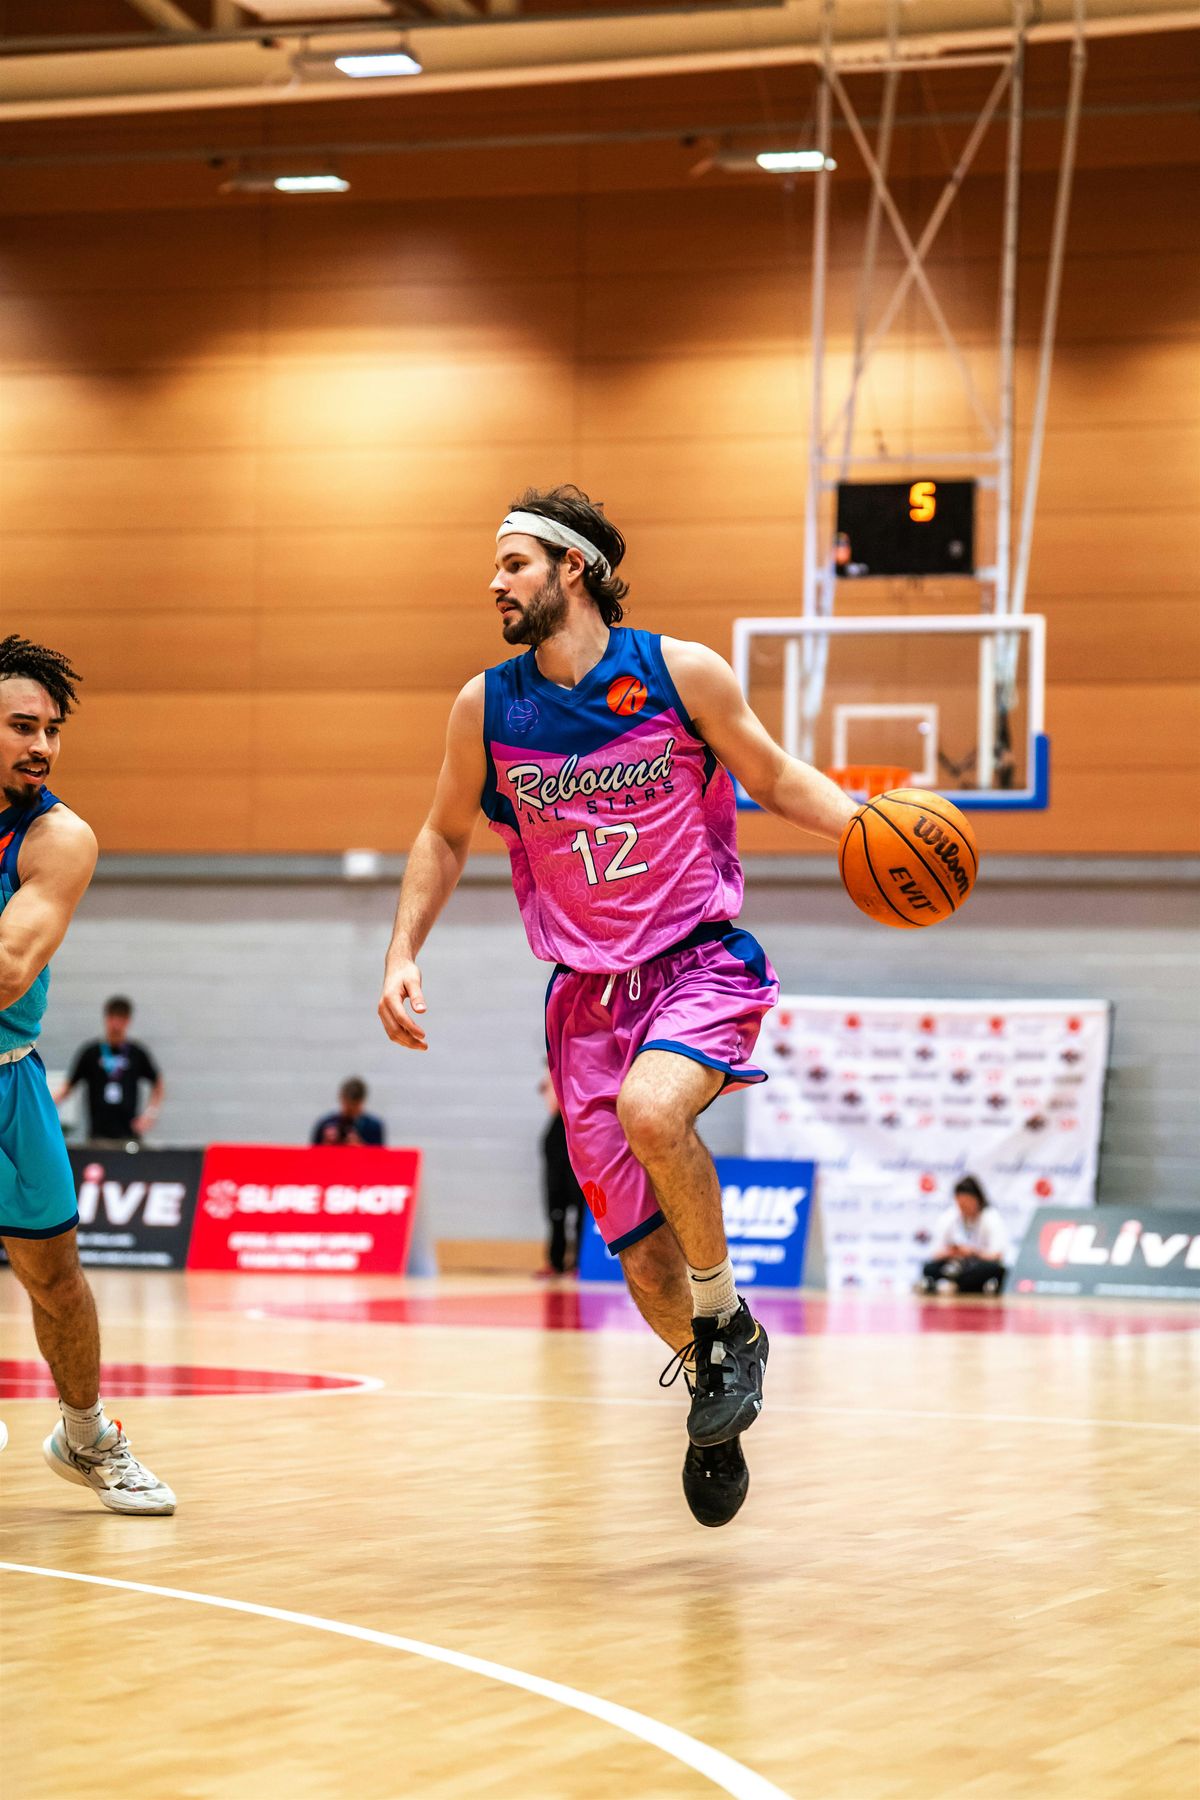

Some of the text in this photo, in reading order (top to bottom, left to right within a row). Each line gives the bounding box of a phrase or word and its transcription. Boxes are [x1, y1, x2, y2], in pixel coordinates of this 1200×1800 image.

[506, 738, 675, 810] Rebound
[527, 780, 675, 825] ALL STARS
[571, 821, 649, 886] 12
[913, 815, 969, 898] Wilson
[237, 1183, 412, 1215] SURE SHOT
